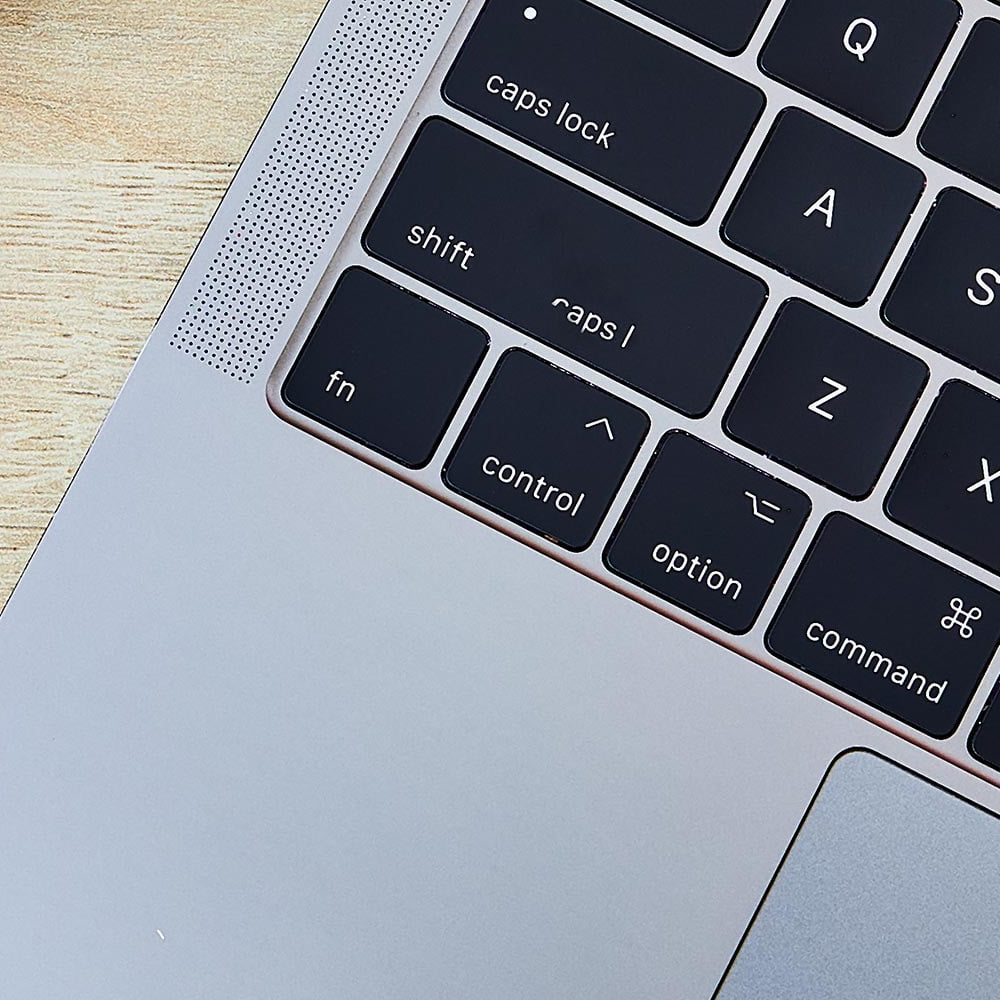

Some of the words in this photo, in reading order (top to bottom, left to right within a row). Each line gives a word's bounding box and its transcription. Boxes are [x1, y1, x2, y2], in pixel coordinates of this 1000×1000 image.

[843, 17, 878, 62] Q
[486, 74, 552, 118] caps
[556, 102, 616, 149] lock
[803, 188, 836, 228] A
[407, 225, 475, 271] shift
[967, 267, 1000, 306] S
[325, 370, 357, 402] fn
[807, 376, 847, 420] Z
[481, 455, 585, 517] control
[966, 457, 1000, 503] X
[651, 541, 744, 601] option
[804, 618, 948, 704] command
